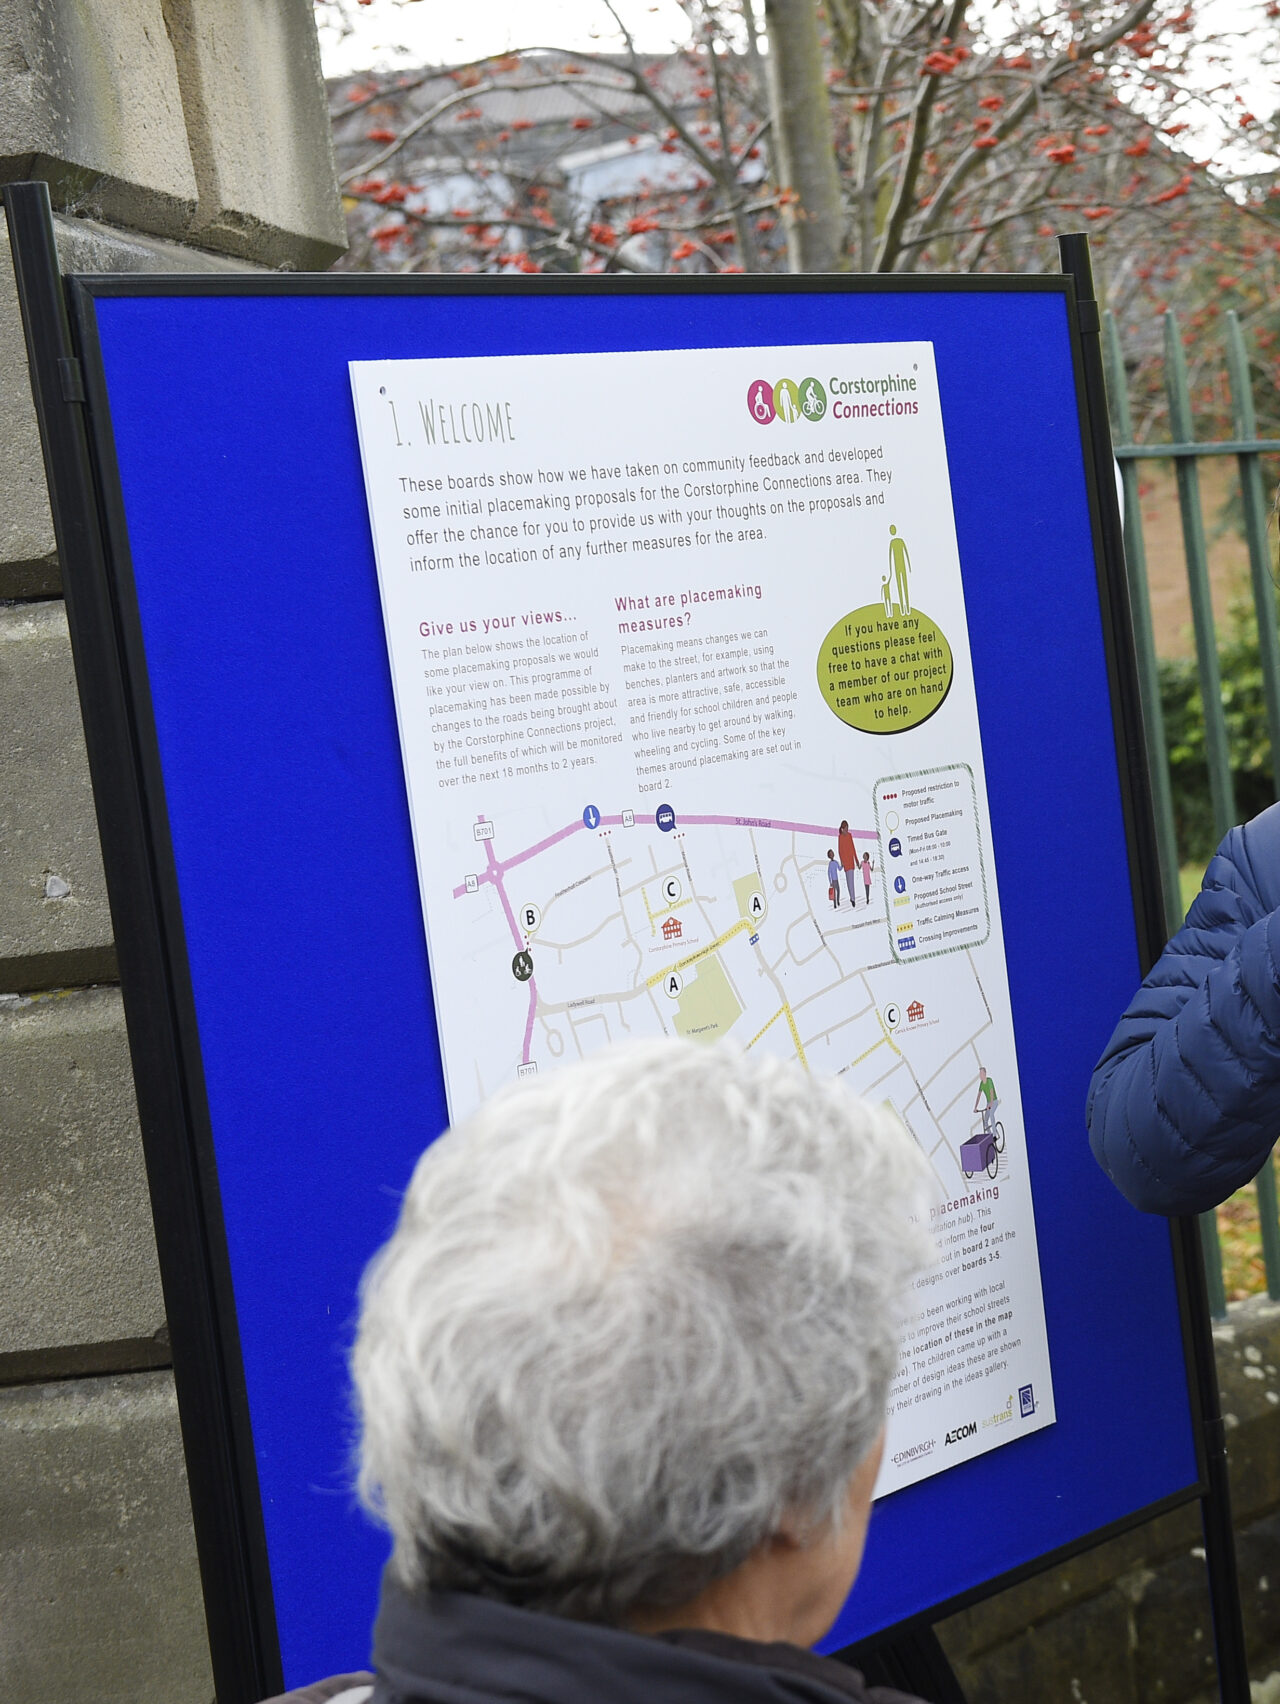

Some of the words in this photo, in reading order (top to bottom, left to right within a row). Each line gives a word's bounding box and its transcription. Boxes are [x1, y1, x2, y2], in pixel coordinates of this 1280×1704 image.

[829, 373, 917, 397] Corstorphine
[832, 397, 919, 420] Connections
[388, 400, 412, 447] 1.
[418, 398, 516, 445] WELCOME
[397, 477, 443, 493] These
[447, 472, 495, 490] boards
[499, 470, 534, 487] show
[537, 468, 564, 484] how
[567, 469, 587, 482] we
[590, 465, 622, 480] have
[625, 462, 660, 478] taken
[663, 463, 679, 475] on
[682, 455, 746, 474] community
[748, 451, 802, 469] feedback
[804, 449, 825, 465] and
[827, 444, 884, 464] developed
[402, 505, 441, 520] some
[445, 498, 483, 516] initial
[487, 493, 571, 517] placemaking
[574, 487, 637, 510] proposals
[639, 486, 657, 502] for
[660, 484, 680, 500] the
[683, 479, 759, 498] Corstorphine
[762, 473, 833, 491] Connections
[835, 473, 864, 486] area.
[865, 468, 893, 485] They
[406, 528, 439, 546] offer
[442, 527, 465, 543] the
[469, 524, 519, 541] chance
[522, 520, 541, 536] for
[544, 521, 569, 539] you
[572, 518, 585, 532] to
[589, 513, 636, 535] provide
[639, 514, 655, 526] us
[657, 508, 683, 525] with
[686, 509, 713, 526] your
[716, 501, 767, 521] thoughts
[769, 503, 785, 515] on
[787, 498, 806, 513] the
[808, 493, 862, 515] proposals
[864, 490, 885, 506] and
[409, 555, 455, 572] inform
[458, 552, 481, 568] the
[484, 547, 538, 565] location
[541, 544, 555, 560] of
[559, 545, 582, 561] any
[585, 539, 628, 556] further
[632, 535, 692, 552] measures
[694, 530, 711, 546] for
[714, 529, 734, 544] the
[737, 528, 767, 542] area.
[614, 594, 651, 612] What
[654, 594, 676, 608] are
[680, 583, 762, 608] placemaking
[419, 621, 454, 638] Give
[459, 620, 477, 633] us
[482, 615, 516, 635] your
[521, 610, 577, 626] views...
[618, 611, 691, 634] measures?
[844, 624, 852, 637] If
[854, 624, 874, 638] you
[876, 621, 899, 632] have
[902, 619, 919, 630] any
[420, 648, 440, 660] The
[442, 646, 463, 661] plan
[465, 643, 493, 655] below
[494, 640, 525, 652] shows
[525, 637, 541, 648] the
[542, 632, 578, 647] location
[579, 630, 589, 642] of
[620, 640, 674, 656] Placemaking
[675, 638, 704, 648] means
[705, 633, 739, 645] changes
[740, 631, 752, 640] we
[753, 629, 768, 639] can
[831, 640, 881, 658] questions
[884, 636, 916, 651] please
[918, 630, 936, 644] feel
[828, 662, 848, 674] free
[850, 659, 862, 671] to
[864, 657, 888, 669] have
[890, 655, 897, 665] a
[899, 650, 921, 664] chat
[922, 647, 943, 660] with
[829, 682, 835, 692] a
[838, 675, 878, 690] member
[880, 671, 891, 684] of
[893, 671, 910, 682] our
[913, 664, 947, 681] project
[835, 696, 861, 708] team
[863, 691, 884, 704] who
[886, 689, 902, 700] are
[905, 687, 918, 697] on
[919, 681, 944, 695] hand
[874, 708, 885, 719] to
[887, 703, 912, 718] help.
[638, 779, 663, 793] board
[664, 778, 673, 789] 2.
[901, 785, 927, 798] Proposed
[927, 781, 954, 793] restriction
[953, 780, 960, 788] to
[902, 800, 919, 809] motor
[919, 796, 935, 806] traffic
[904, 813, 931, 827] Proposed
[930, 809, 963, 822] Placemaking
[476, 827, 492, 838] B701
[906, 832, 924, 843] Timed
[923, 831, 935, 840] Bus
[934, 829, 948, 838] Gate
[911, 873, 935, 884] One-way
[934, 868, 952, 879] Traffic
[951, 865, 970, 875] access
[667, 881, 676, 897] C
[913, 888, 939, 904] Proposed
[939, 883, 958, 895] School
[957, 880, 974, 891] Street
[752, 896, 762, 912] A
[525, 909, 536, 926] B
[916, 916, 934, 927] Traffic
[933, 912, 955, 923] Calming
[955, 906, 980, 918] Measures
[918, 932, 943, 944] Crossing
[942, 923, 979, 939] Improvements
[669, 976, 679, 992] A
[888, 1008, 895, 1023] C
[929, 1186, 1000, 1219] pacemaking
[916, 1272, 944, 1289] designs
[944, 1266, 961, 1279] over
[961, 1256, 987, 1272] boards
[988, 1250, 1002, 1262] 3-5.
[912, 1337, 943, 1355] location
[944, 1331, 953, 1343] of
[953, 1325, 975, 1339] these
[975, 1321, 983, 1331] in
[984, 1316, 997, 1328] the
[997, 1310, 1013, 1323] map
[896, 1396, 913, 1411] their
[914, 1386, 943, 1404] drawing
[943, 1382, 951, 1392] in
[951, 1377, 964, 1389] the
[963, 1369, 984, 1384] ideas
[984, 1360, 1009, 1378] gallery.
[944, 1421, 978, 1447] AECOM
